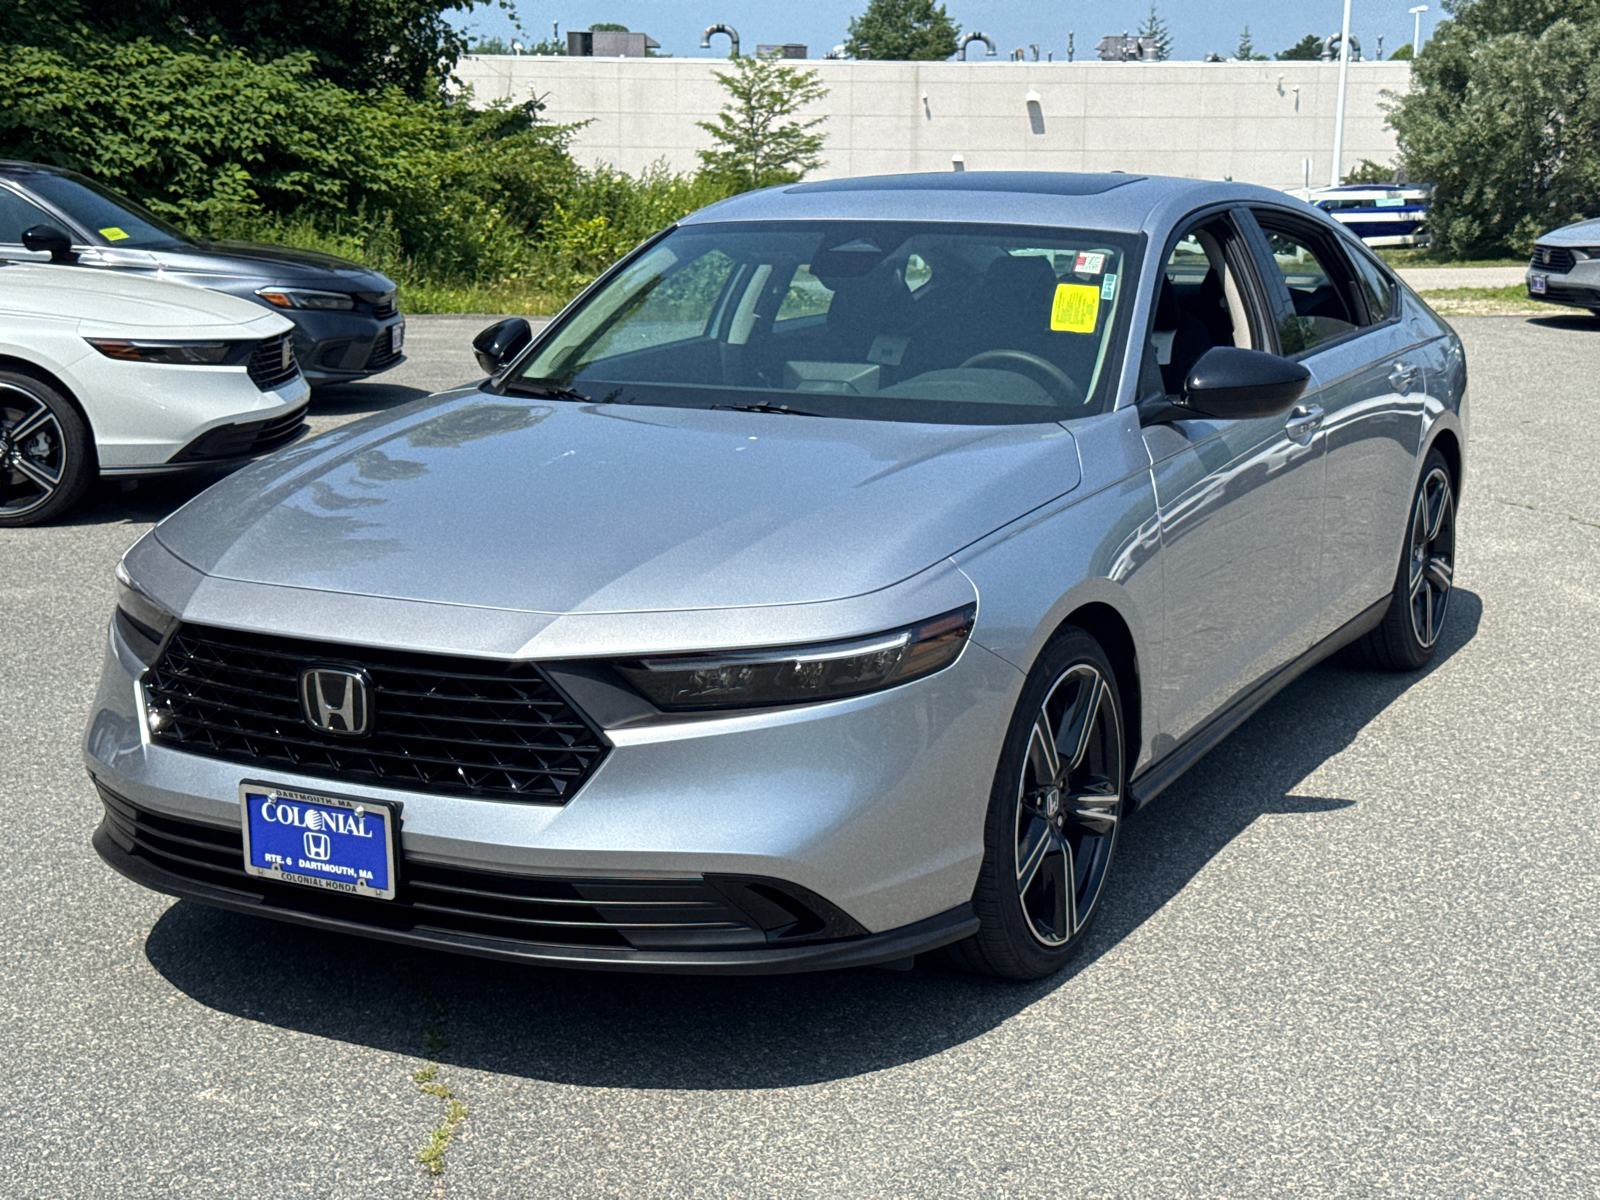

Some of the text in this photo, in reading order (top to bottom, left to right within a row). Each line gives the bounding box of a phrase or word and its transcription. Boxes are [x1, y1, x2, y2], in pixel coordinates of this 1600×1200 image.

[338, 800, 352, 808] MA
[261, 802, 373, 838] COLONIAL
[265, 853, 373, 880] RTE. 6 DARTMOUTH, MA
[281, 872, 357, 893] COLONIAL HONDA
